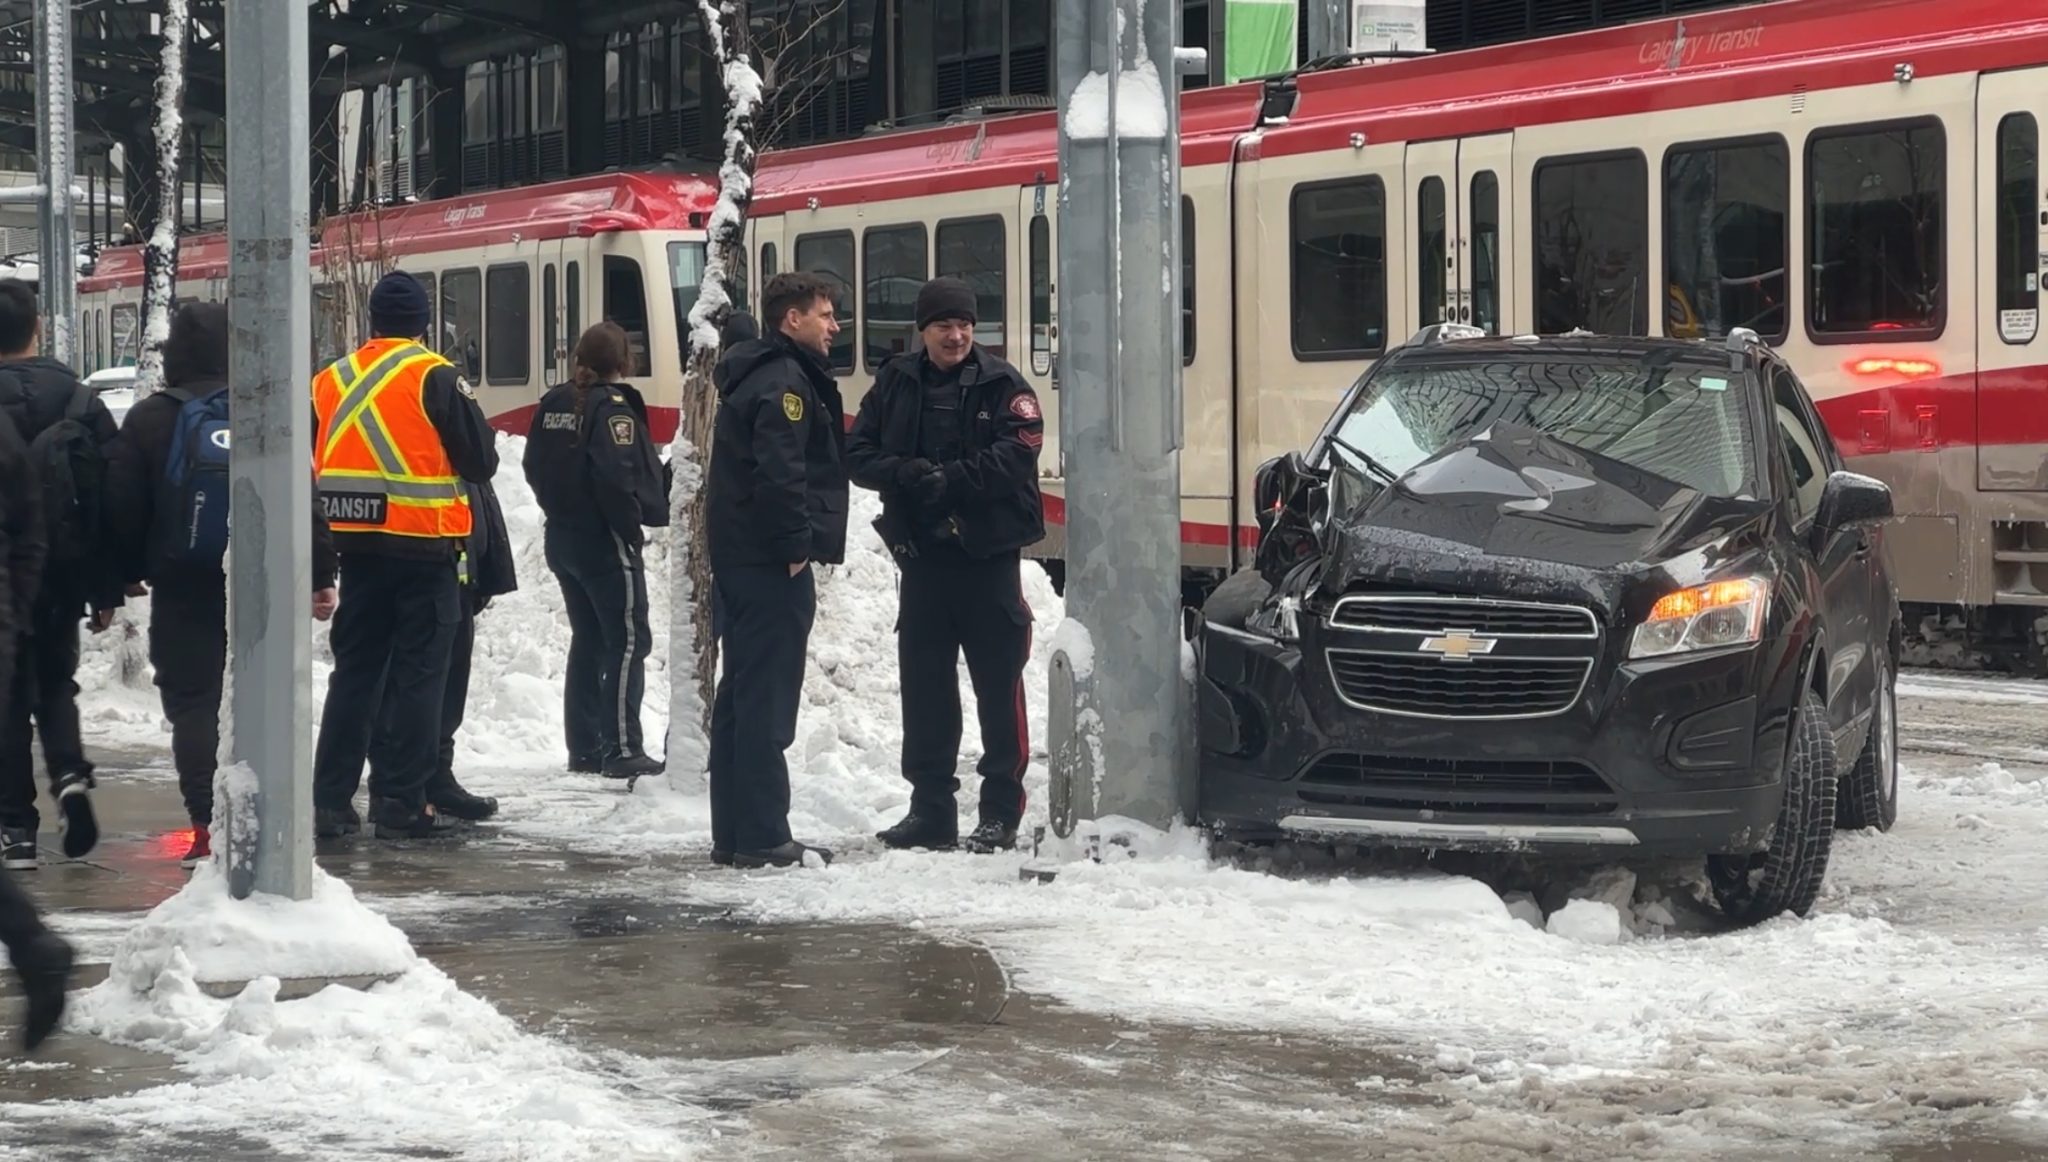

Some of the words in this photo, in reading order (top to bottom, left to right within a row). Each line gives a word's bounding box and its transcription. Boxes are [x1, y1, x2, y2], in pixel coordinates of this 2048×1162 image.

[1638, 36, 1703, 69] Calgry
[1706, 23, 1765, 54] Transit
[542, 411, 560, 430] PEACE
[320, 496, 381, 520] RANSIT
